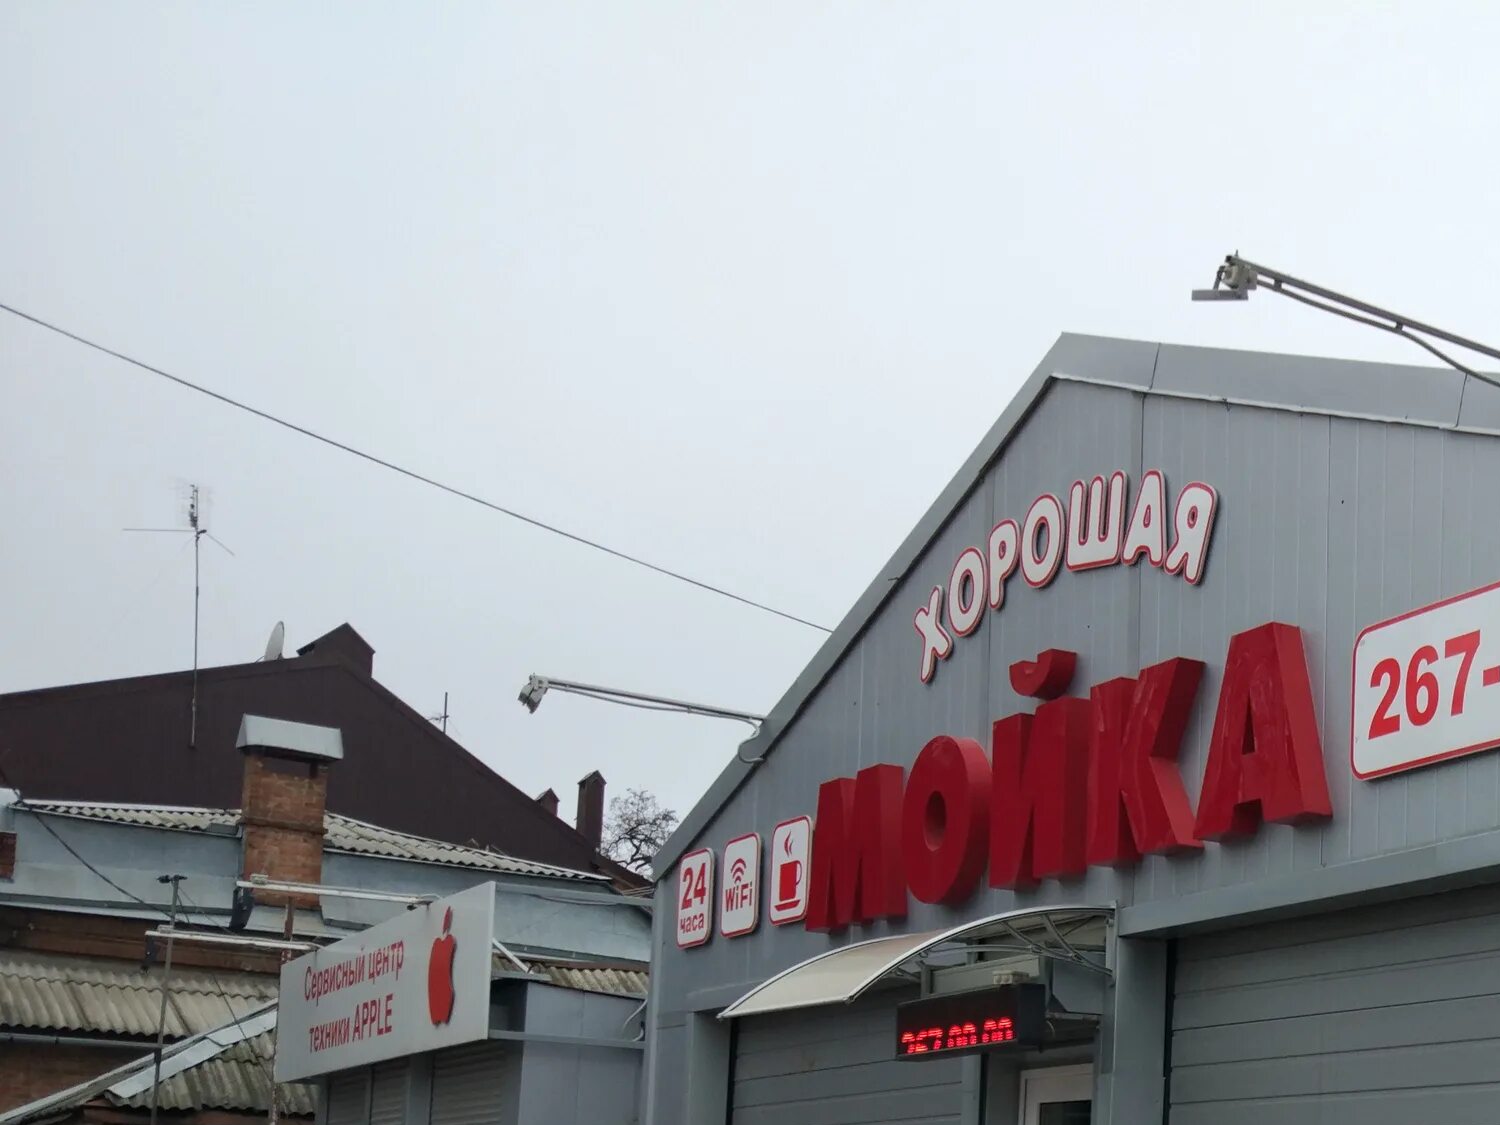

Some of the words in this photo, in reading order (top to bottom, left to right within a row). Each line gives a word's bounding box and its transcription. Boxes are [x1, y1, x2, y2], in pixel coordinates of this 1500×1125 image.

[914, 469, 1218, 684] ХОРОШАЯ
[806, 621, 1333, 933] МОЙКА
[680, 862, 707, 911] 24
[679, 912, 705, 934] часа
[304, 945, 366, 1007] Сервисный
[368, 940, 404, 985] центр
[309, 1017, 351, 1053] техники
[351, 993, 394, 1043] APPLE
